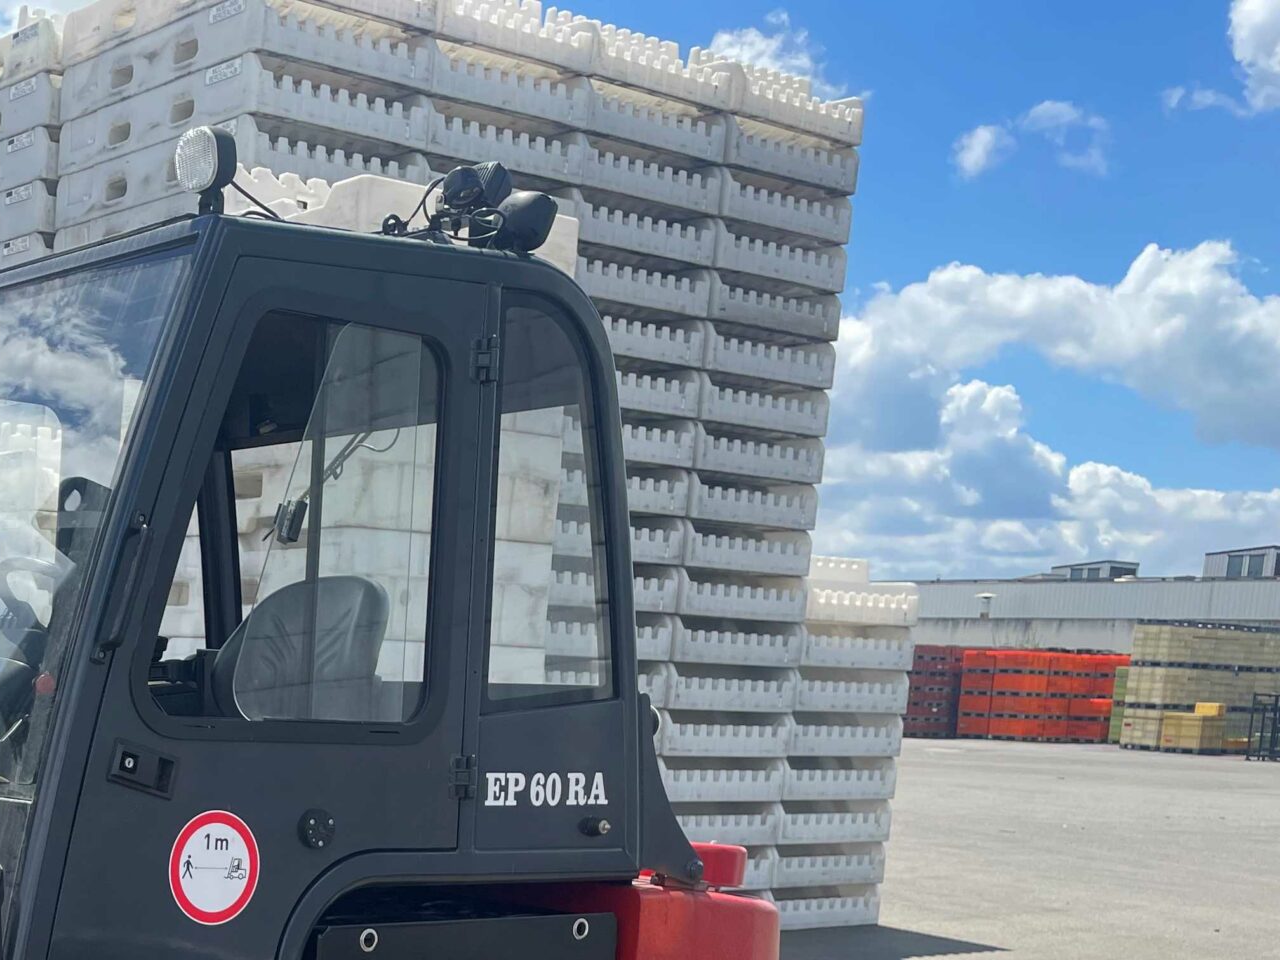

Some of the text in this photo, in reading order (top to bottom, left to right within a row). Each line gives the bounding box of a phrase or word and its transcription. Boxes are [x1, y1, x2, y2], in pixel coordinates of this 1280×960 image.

[484, 772, 609, 807] EP 60 RA
[204, 833, 229, 851] 1 m
